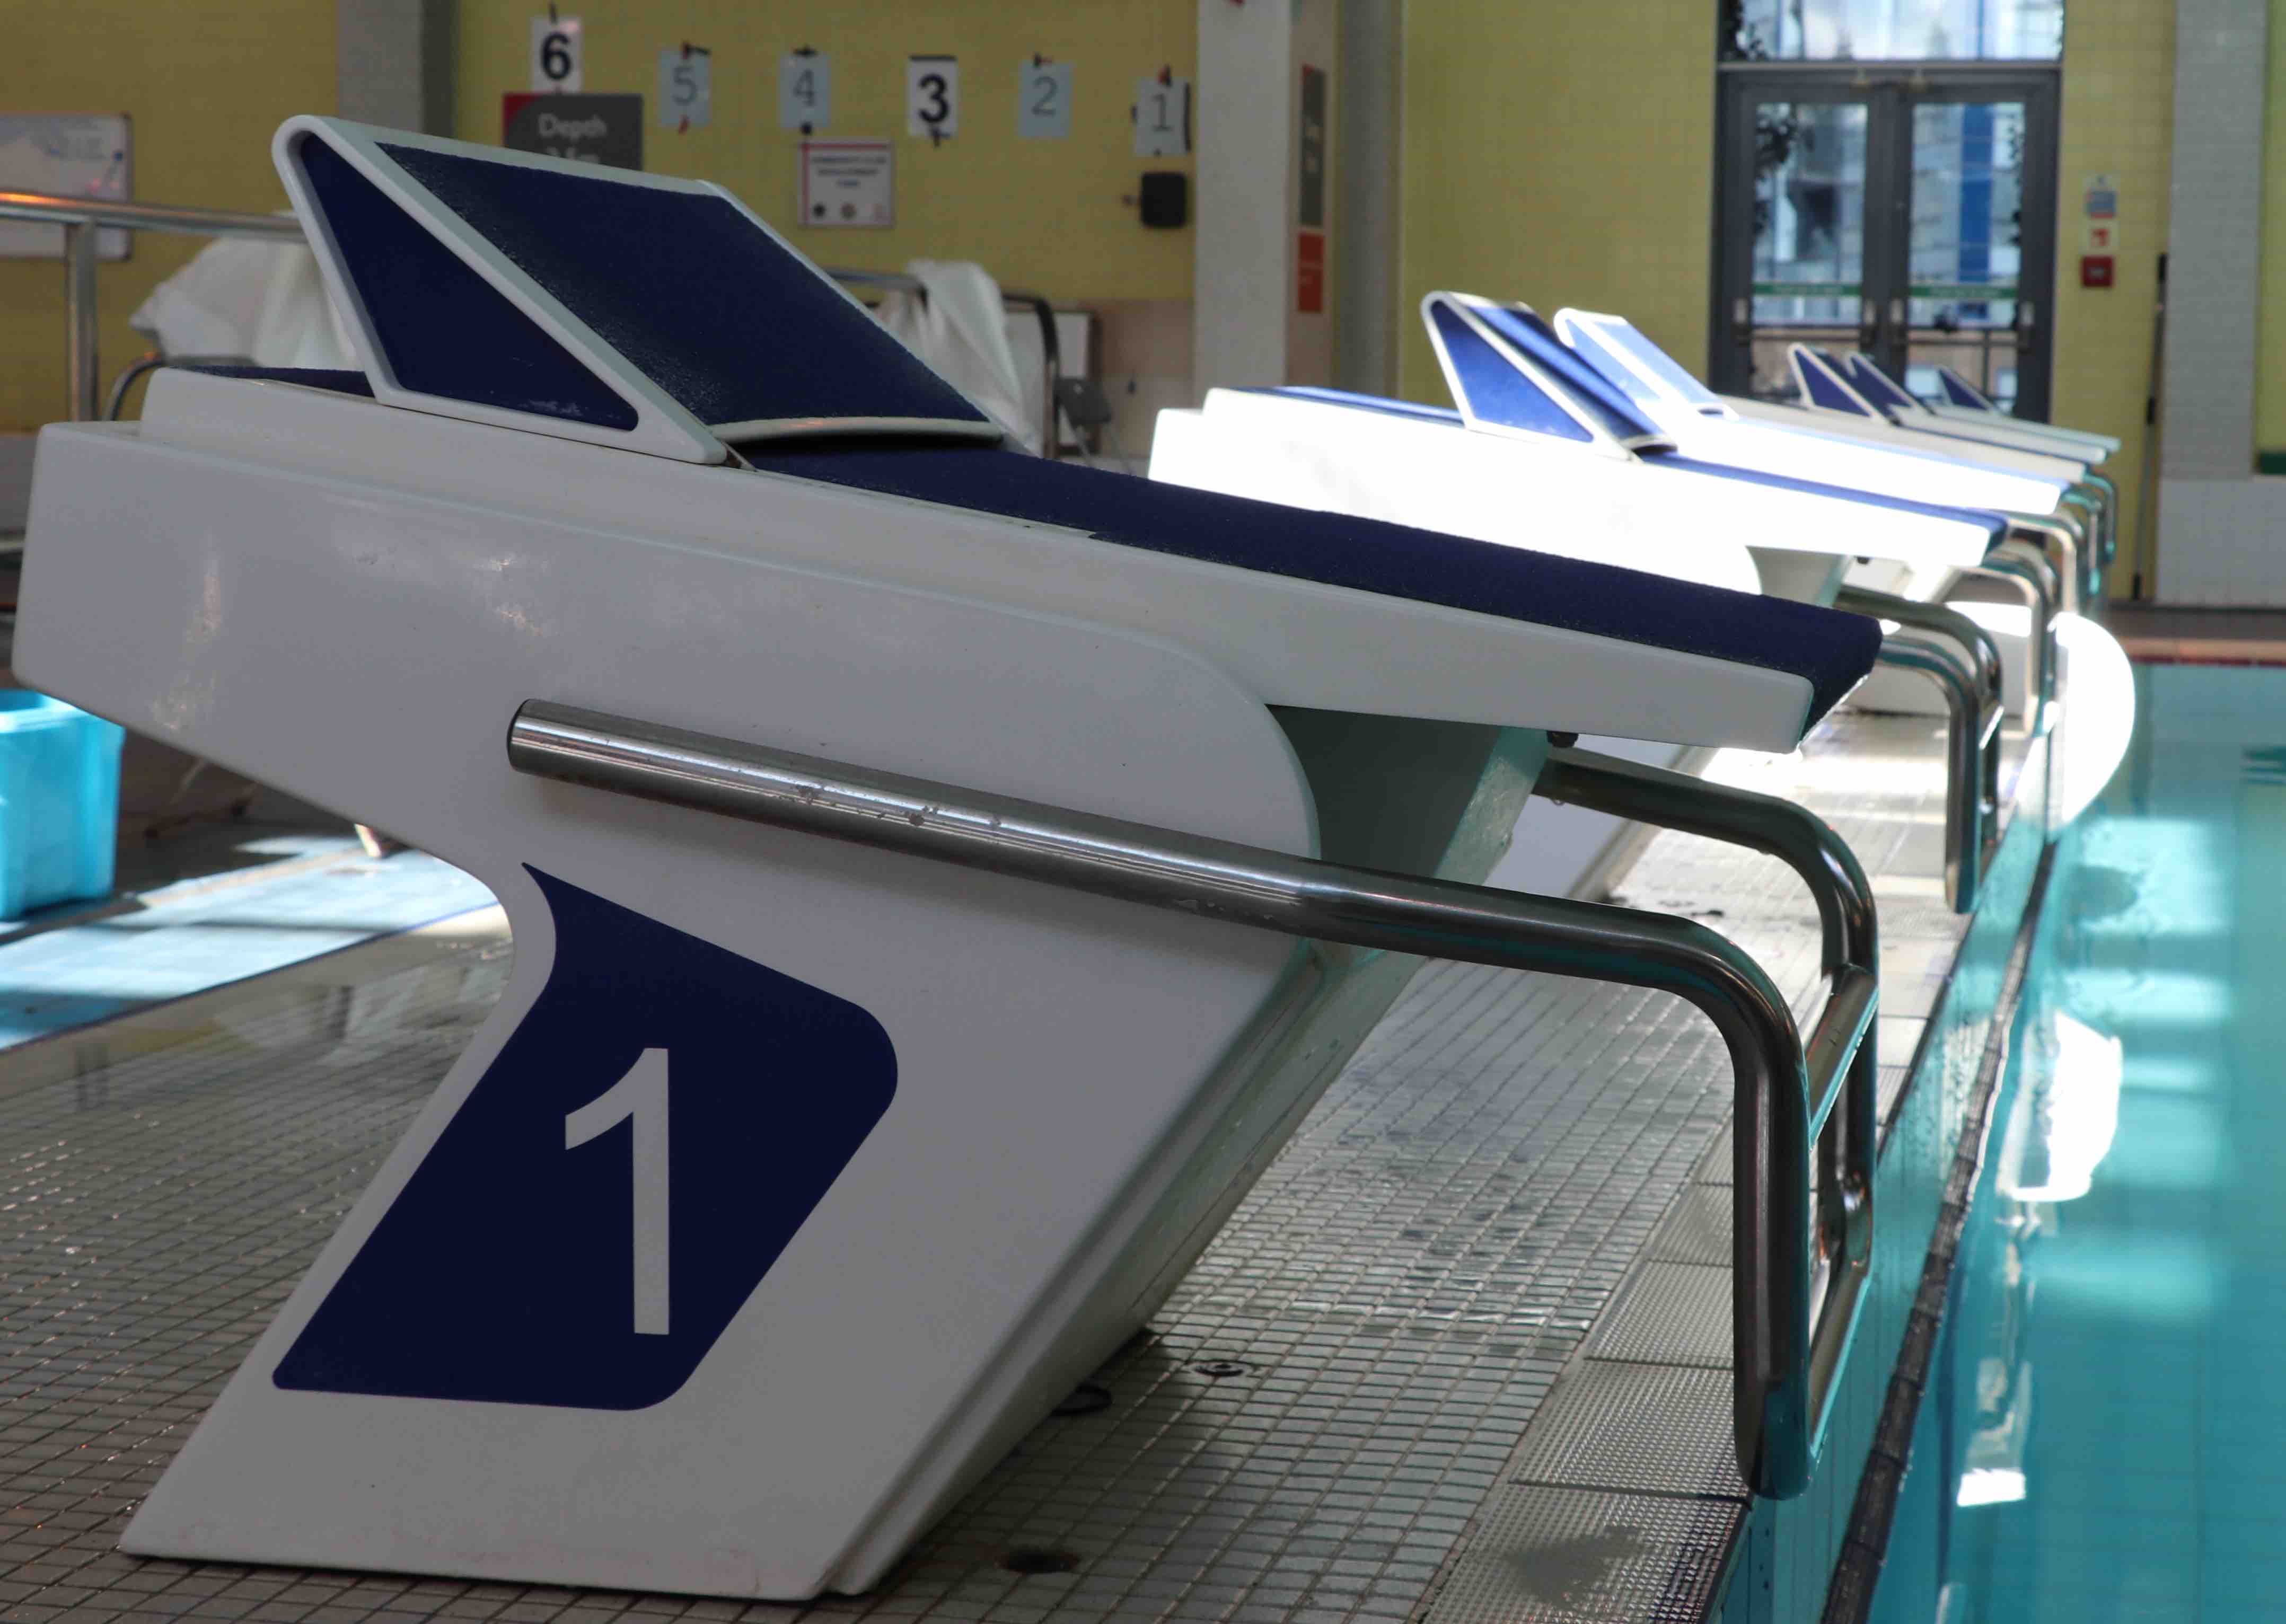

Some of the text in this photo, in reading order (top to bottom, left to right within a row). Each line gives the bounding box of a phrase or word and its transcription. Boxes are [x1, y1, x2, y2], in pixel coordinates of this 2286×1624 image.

[540, 31, 573, 80] 6
[673, 66, 698, 106] 5
[794, 69, 815, 107] 4
[918, 74, 949, 124] 3
[1032, 76, 1057, 116] 2
[538, 113, 607, 142] Depth
[1151, 93, 1173, 133] 1
[565, 1047, 669, 1335] 1
